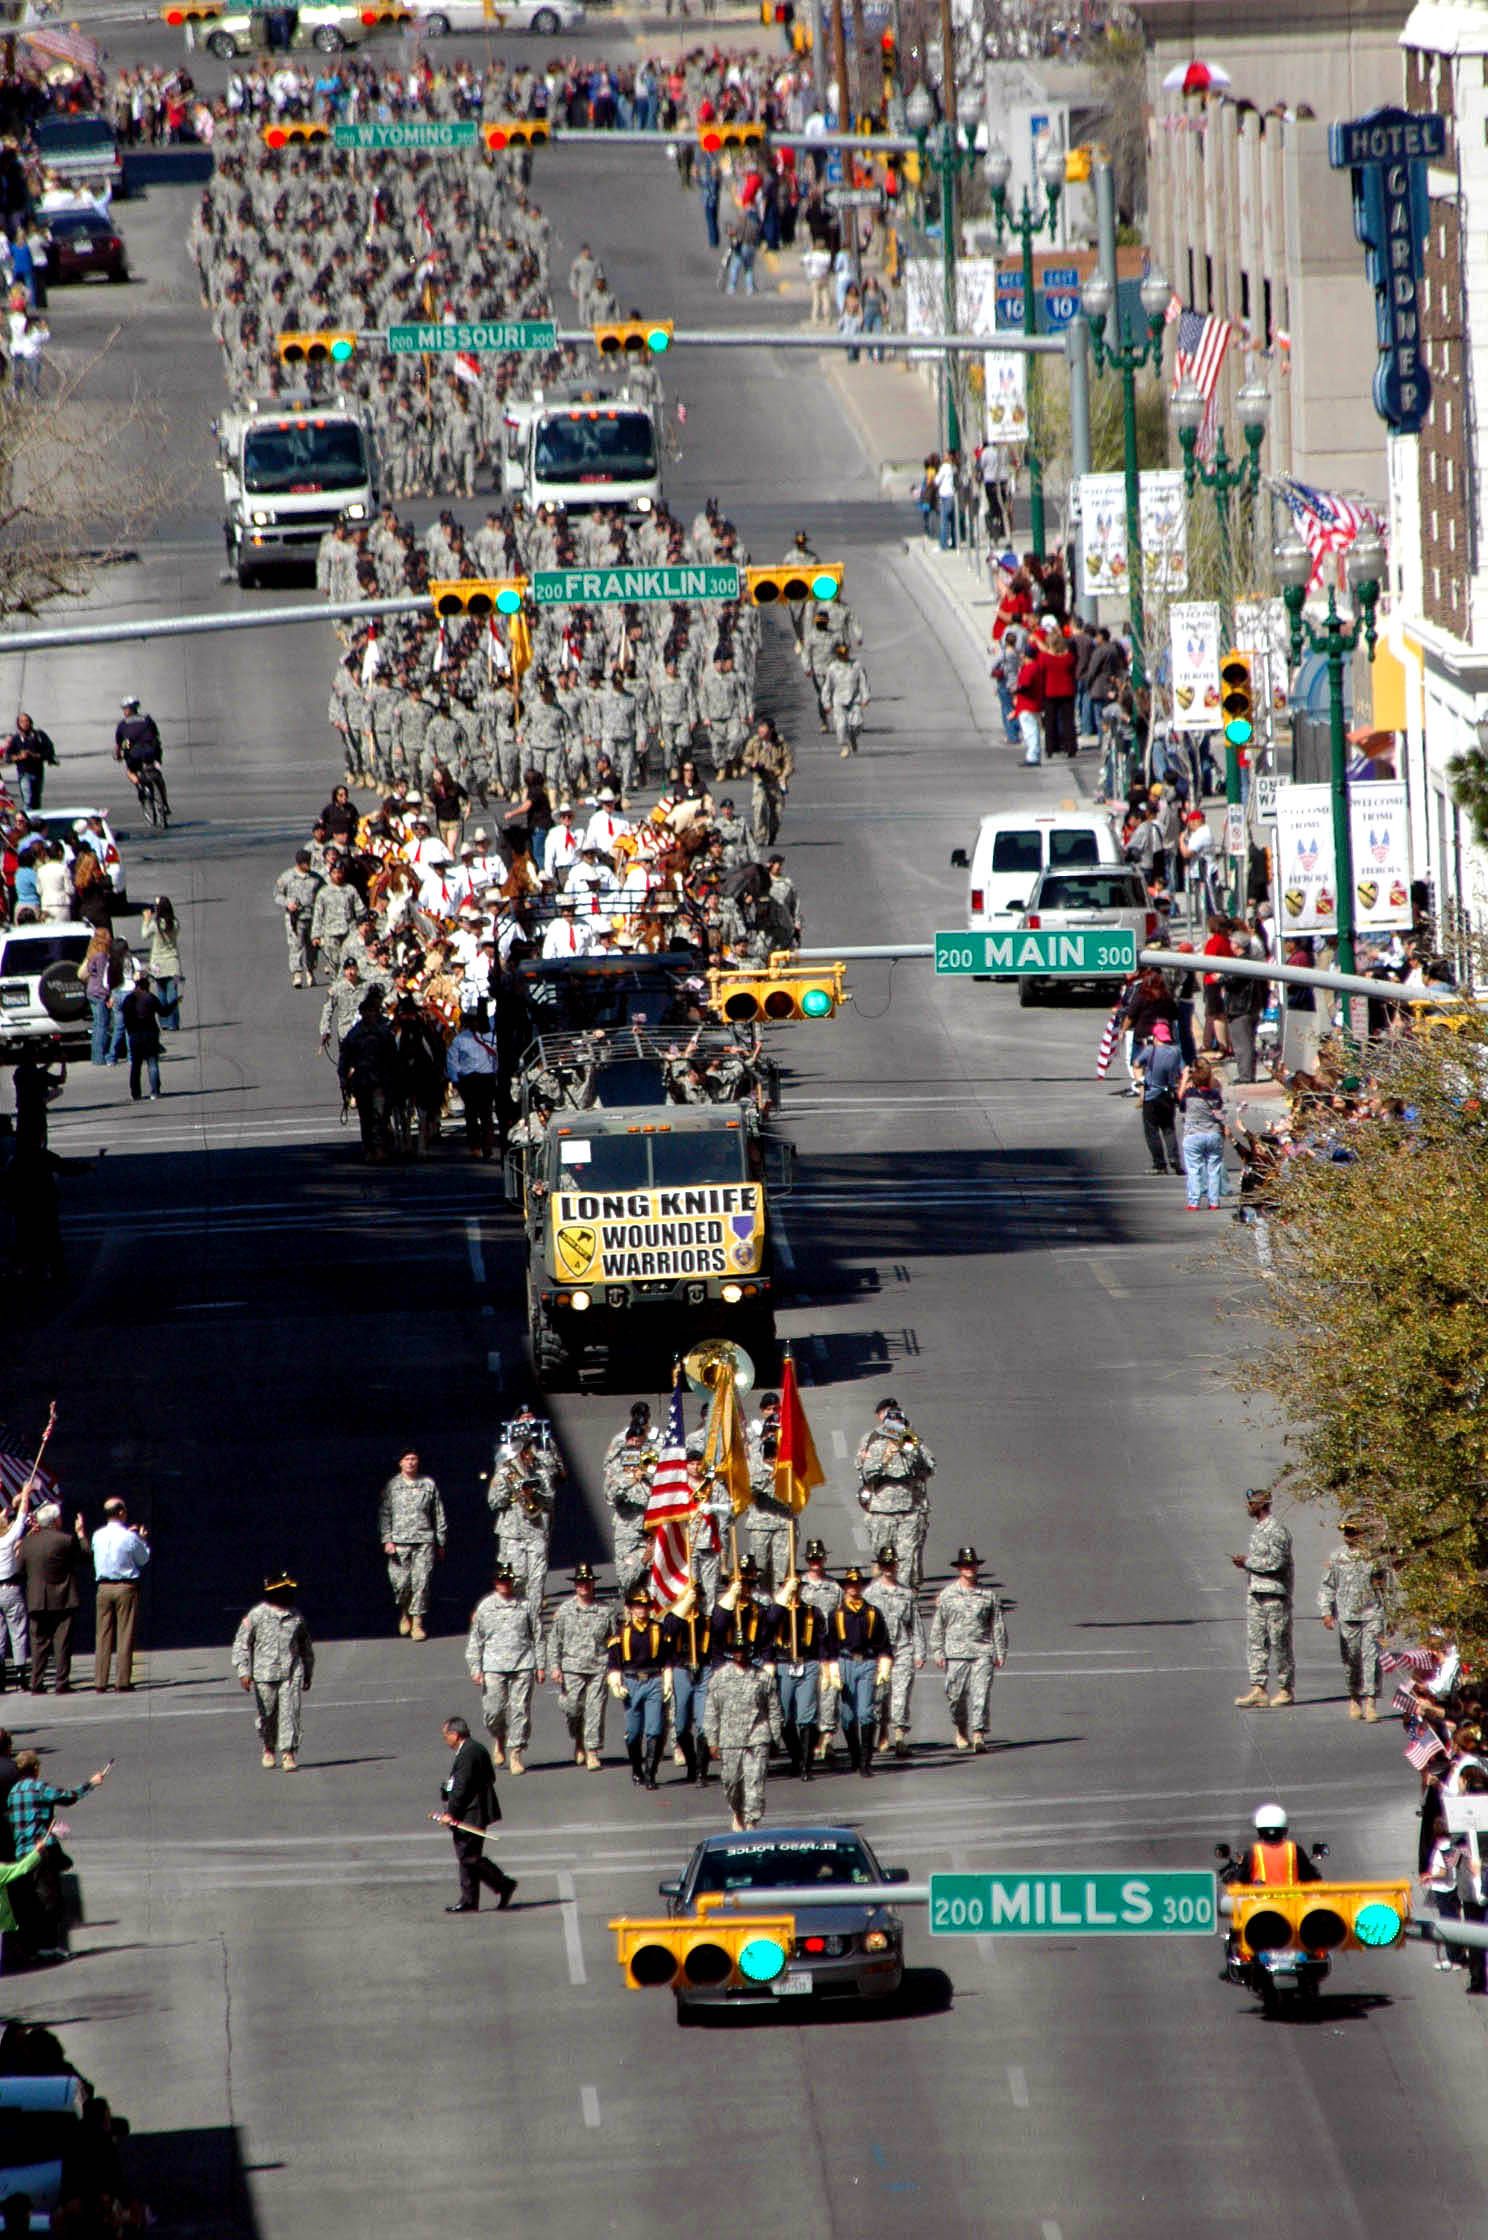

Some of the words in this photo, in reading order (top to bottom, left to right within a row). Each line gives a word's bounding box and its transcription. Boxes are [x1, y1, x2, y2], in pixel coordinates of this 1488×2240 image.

[358, 127, 453, 145] WYOMING
[1351, 124, 1438, 157] HOTEL
[1387, 164, 1418, 411] GARDNER
[1005, 297, 1025, 320] 10
[1053, 296, 1073, 320] 10
[391, 335, 413, 349] 200
[418, 327, 526, 348] MISSOURI
[536, 583, 563, 600] 200
[565, 570, 706, 599] FRANKLIN
[709, 578, 736, 594] 300
[937, 949, 973, 968] 200
[984, 935, 1085, 967] MAIN
[1097, 947, 1132, 966] 300
[561, 1194, 650, 1221] LONG
[660, 1187, 757, 1216] KNIFE
[602, 1220, 723, 1249] WOUNDED
[602, 1248, 727, 1277] WARRIORS
[934, 1898, 984, 1926] 200
[991, 1880, 1153, 1925] MILLS
[1161, 1896, 1212, 1925] 300
